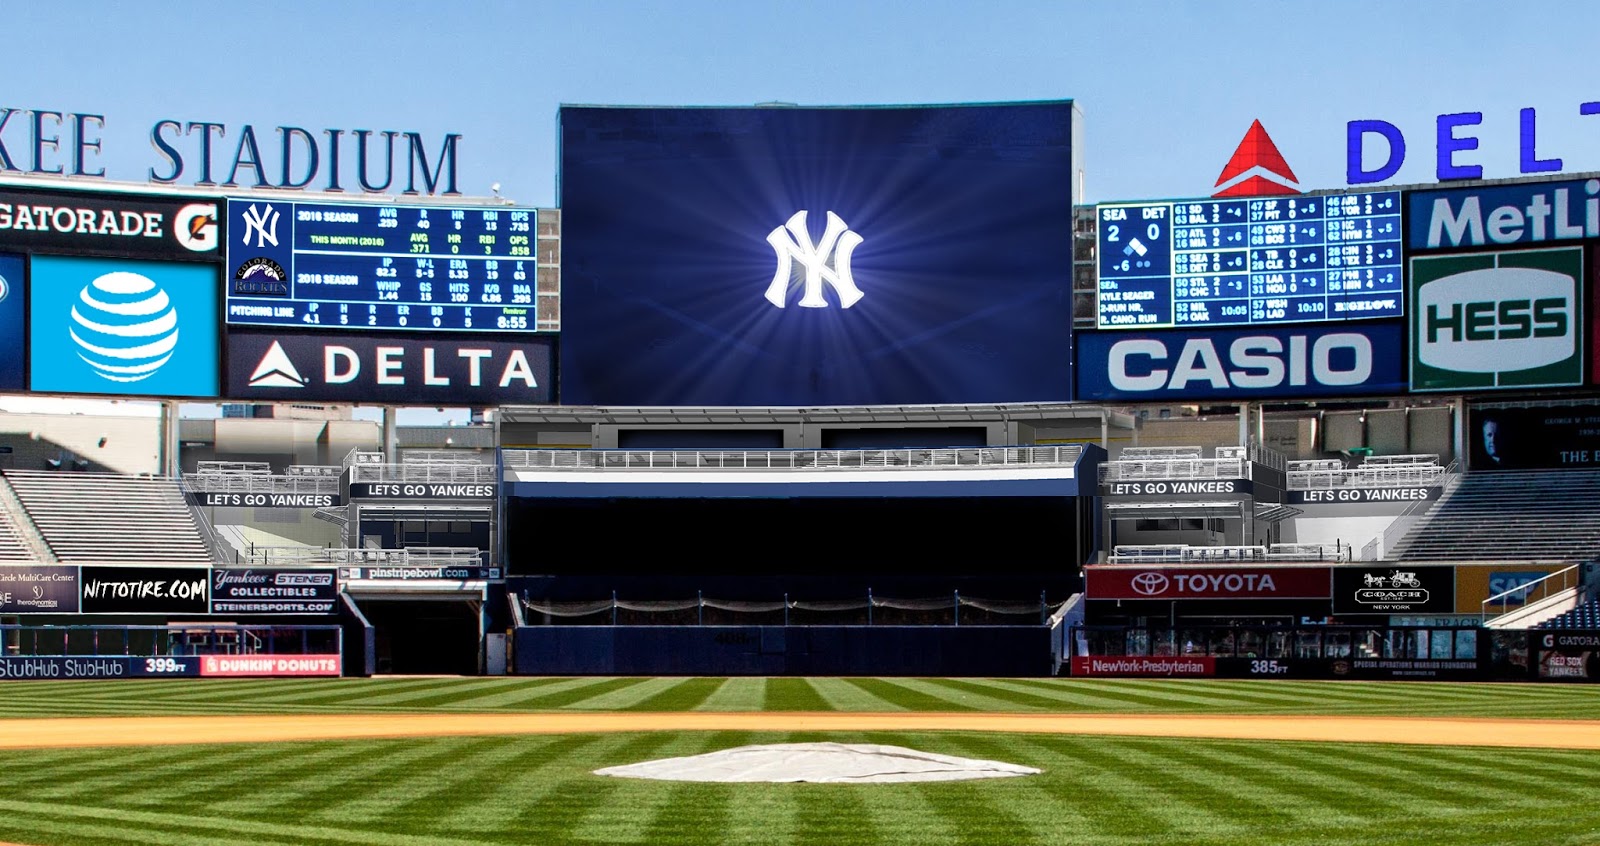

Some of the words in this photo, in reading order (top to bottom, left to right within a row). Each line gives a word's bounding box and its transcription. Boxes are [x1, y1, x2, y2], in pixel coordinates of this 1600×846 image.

[150, 119, 463, 195] STADIUM
[323, 212, 358, 223] SEASON
[379, 209, 397, 218] AVG
[452, 211, 464, 220] HR
[483, 212, 498, 220] RBI
[511, 212, 529, 221] OPS
[1103, 209, 1127, 221] SEA
[1142, 207, 1166, 219] DET
[1427, 179, 1600, 248] MetLi
[0, 204, 162, 237] GATORADE
[417, 220, 430, 229] 40
[486, 222, 497, 230] 15
[1108, 225, 1119, 241] 2
[1147, 224, 1159, 240] 0
[1189, 229, 1206, 238] ATL
[311, 235, 329, 243] THIS
[330, 236, 358, 244] MONTH
[359, 238, 384, 246] (2016)
[410, 233, 428, 242] AVG
[448, 235, 461, 243] HR
[479, 235, 495, 244] RBI
[510, 236, 528, 245] OPS
[410, 244, 430, 253] .371
[383, 258, 393, 267] IP
[417, 259, 434, 268] W-L
[450, 260, 467, 269] ERA
[486, 261, 498, 269] BB
[1190, 254, 1208, 262] SEA
[237, 257, 285, 278] COLORADO
[1190, 264, 1208, 272] DET
[323, 275, 358, 285] SEASON
[1190, 278, 1207, 287] STL
[1266, 275, 1283, 283] LAA
[235, 281, 287, 293] ROCKIES
[377, 282, 401, 291] WHIP
[420, 282, 432, 291] GS
[449, 283, 469, 292] HITS
[484, 284, 499, 293] K/9
[513, 284, 531, 294] BAA
[1266, 284, 1286, 293] HOU
[378, 292, 398, 300] 1.44
[420, 293, 432, 301] 15
[451, 293, 468, 302] 100
[1100, 293, 1121, 301] KYLE
[1122, 291, 1154, 300] SEAGER
[231, 306, 272, 316] PITCHING
[274, 307, 294, 317] LINE
[309, 303, 319, 312] IP
[398, 306, 409, 315] ER
[431, 307, 443, 315] BB
[1190, 303, 1207, 312] MIL
[1221, 306, 1247, 315] 10:05
[1298, 303, 1324, 312] 10:10
[303, 313, 320, 324] 4.1
[497, 317, 527, 328] 8:55
[1426, 297, 1567, 344] HESS
[324, 345, 537, 388] DELTA
[1107, 333, 1372, 392] CASIO
[1560, 451, 1589, 462] THE
[369, 485, 400, 496] LET'S
[404, 486, 426, 496] GO
[430, 486, 493, 496] YANKEES
[1145, 483, 1166, 494] GO
[1171, 482, 1234, 493] YANKEES
[207, 494, 240, 505] LET'S
[244, 494, 266, 505] GO
[270, 494, 332, 506] YANKEES
[1304, 491, 1334, 501] LET'S
[1339, 490, 1360, 500] GO
[1364, 489, 1427, 500] YANKEES
[369, 568, 468, 579] pinstripebowl.com
[214, 570, 267, 590] Yankees
[276, 574, 331, 584] STEINER
[1174, 574, 1276, 591] TOYOTA
[84, 578, 206, 602] NITTOTIRE.COM
[230, 588, 316, 596] COLLECTIBLES
[1490, 579, 1535, 600] SAP
[214, 603, 332, 611] STEINERSPORTS.COM
[146, 658, 185, 673] 399FT
[220, 660, 276, 672] DUNKIN'
[278, 660, 336, 672] DONUTS
[1251, 660, 1288, 673] 385FT
[1550, 657, 1565, 666] RED
[1567, 657, 1582, 666] SOX
[0, 660, 59, 677] StubHub
[65, 660, 123, 676] StubHub
[1093, 660, 1203, 675] NewYork-Presbyterian
[1549, 667, 1583, 676] YANKEES
